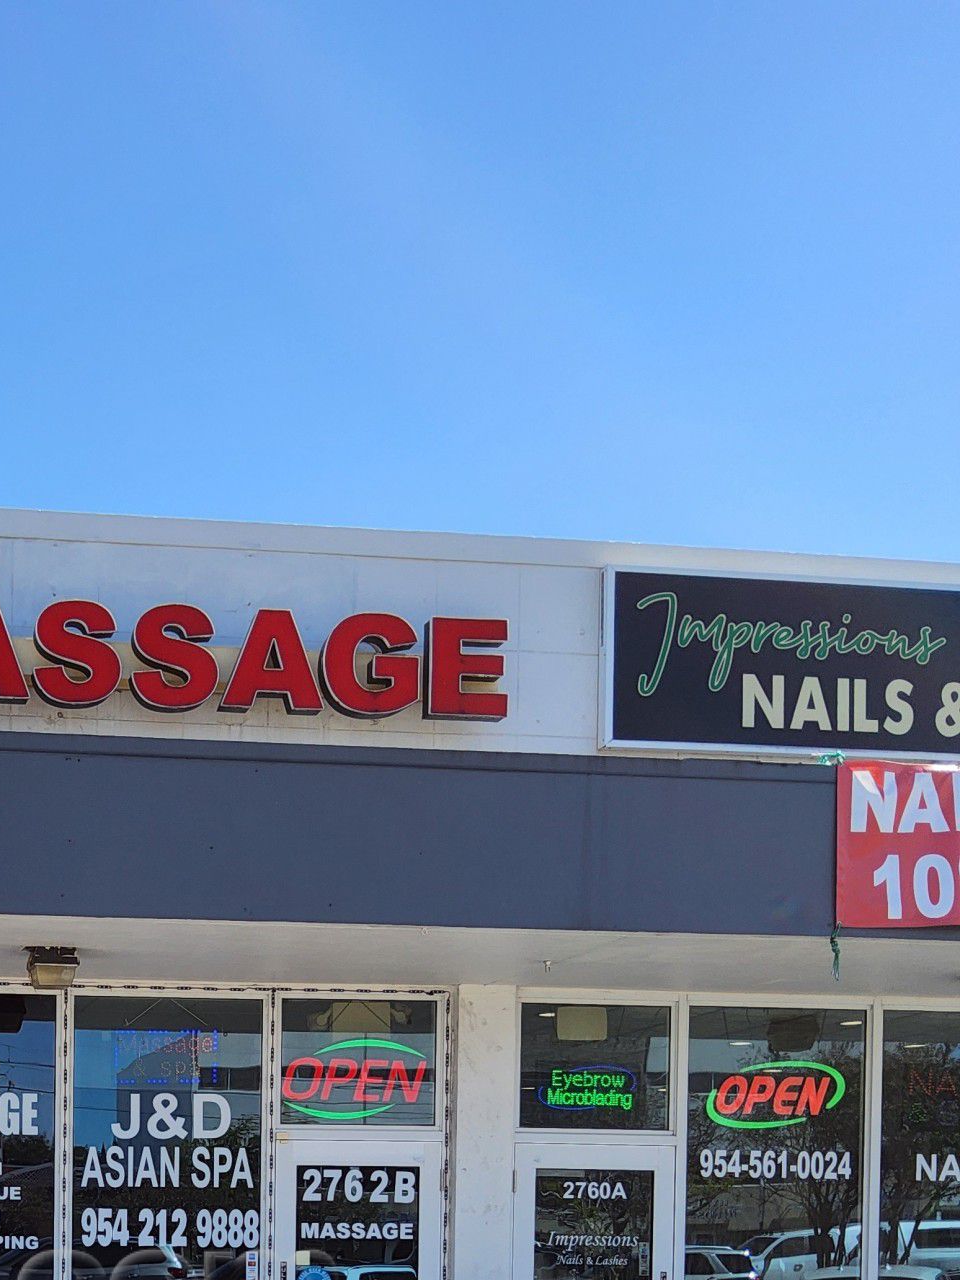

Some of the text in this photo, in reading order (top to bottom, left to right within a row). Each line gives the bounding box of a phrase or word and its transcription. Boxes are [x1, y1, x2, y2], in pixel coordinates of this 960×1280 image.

[637, 592, 946, 696] Impressions
[742, 673, 960, 738] NAILS &
[282, 1056, 427, 1103] OPEN
[551, 1069, 625, 1089] Eyebrow
[715, 1074, 830, 1116] OPEN
[547, 1088, 632, 1110] Microblading
[111, 1093, 232, 1140] J&D
[81, 1146, 254, 1190] ASIAN SPA
[700, 1149, 852, 1181] 954-561-0024
[915, 1153, 960, 1181] NA
[302, 1168, 416, 1204] 2762B
[563, 1181, 628, 1199] 2760A
[81, 1207, 259, 1249] 954 212 9888
[301, 1223, 414, 1240] MASSAGE
[546, 1231, 640, 1251] Impressions
[556, 1254, 628, 1266] Nails & Lashes
